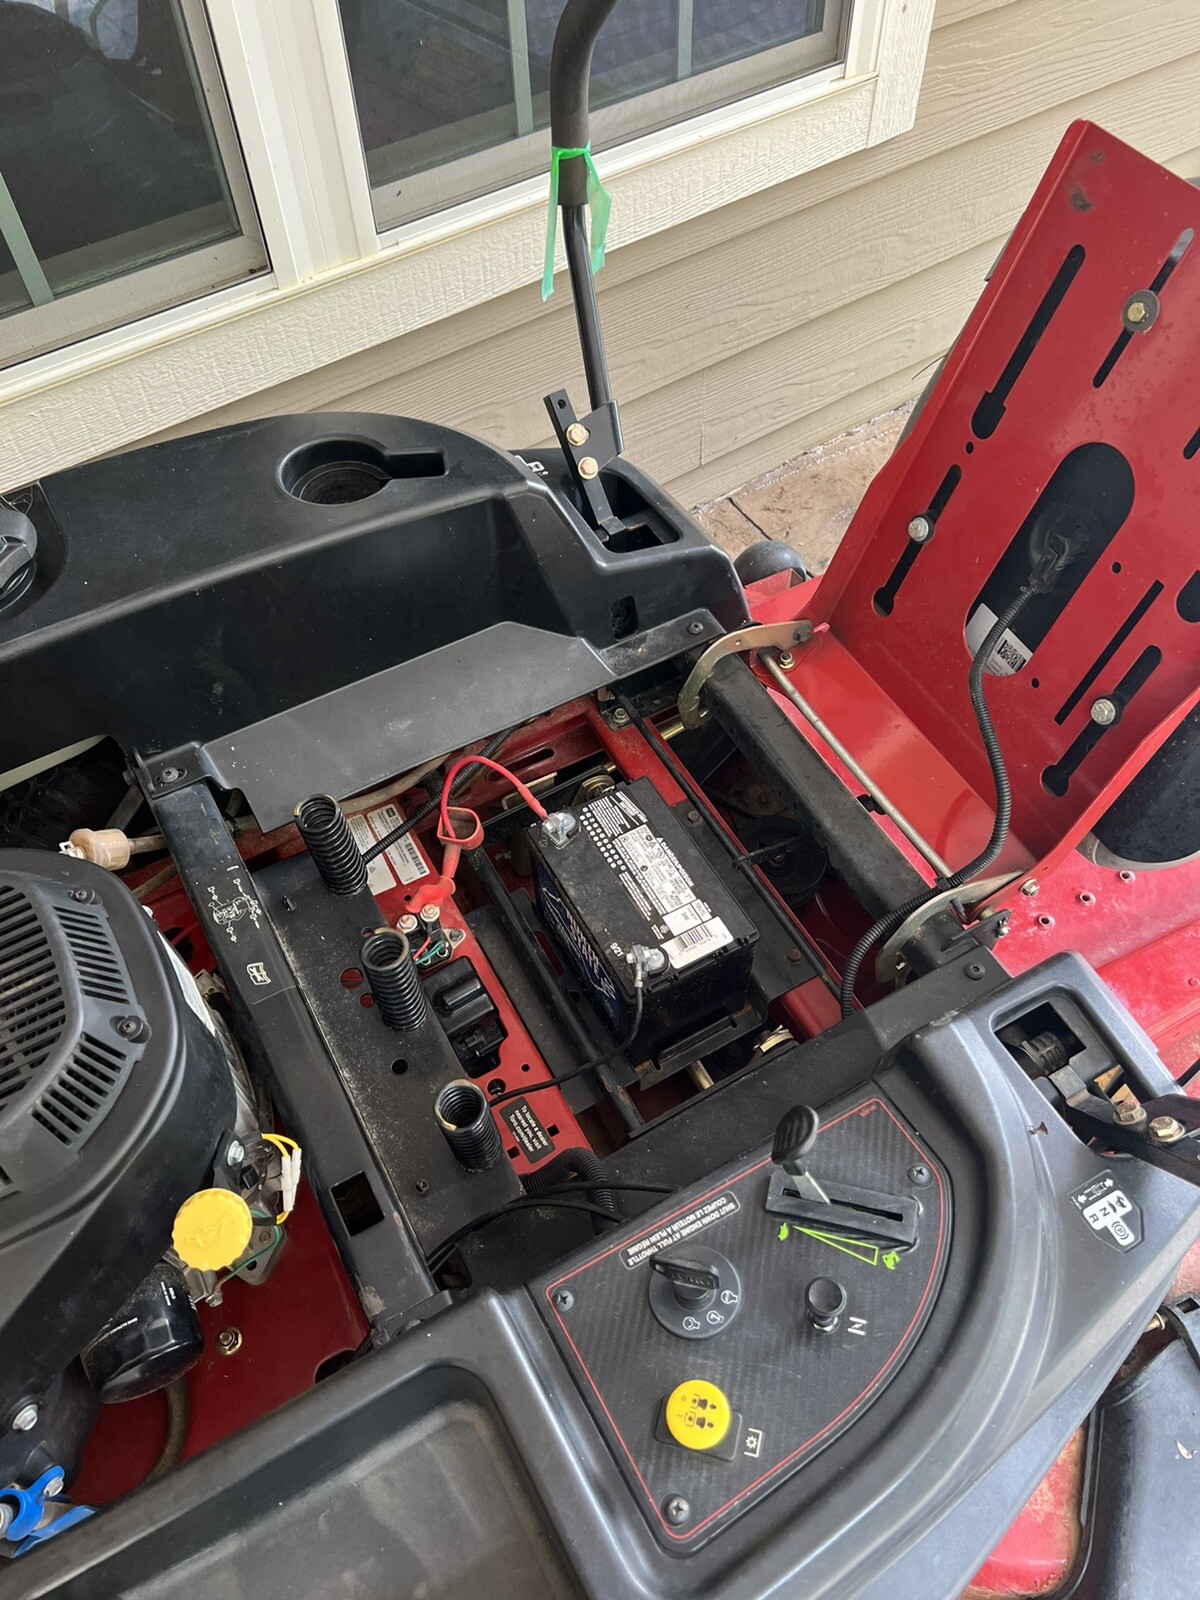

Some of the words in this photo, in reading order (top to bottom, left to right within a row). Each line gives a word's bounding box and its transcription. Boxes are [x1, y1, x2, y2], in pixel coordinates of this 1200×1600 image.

[508, 1114, 535, 1152] Toro.com/dealer
[514, 1109, 529, 1128] nearest
[532, 1138, 542, 1150] visit
[521, 1105, 528, 1113] To
[525, 1111, 537, 1127] locate
[536, 1131, 549, 1146] dealer
[696, 1209, 704, 1217] LE
[704, 1197, 726, 1214] COUPEZ
[719, 1202, 735, 1215] SHUT
[1099, 1206, 1110, 1218] N
[672, 1215, 697, 1232] MOTEUR
[702, 1211, 720, 1225] DOWN
[1089, 1213, 1100, 1224] R
[681, 1220, 703, 1236] ENGINE
[650, 1229, 667, 1243] PLEIN
[658, 1237, 672, 1250] FULL
[671, 1232, 681, 1242] AT
[626, 1239, 651, 1256] RÉGIME
[627, 1245, 659, 1266] THROTTLE
